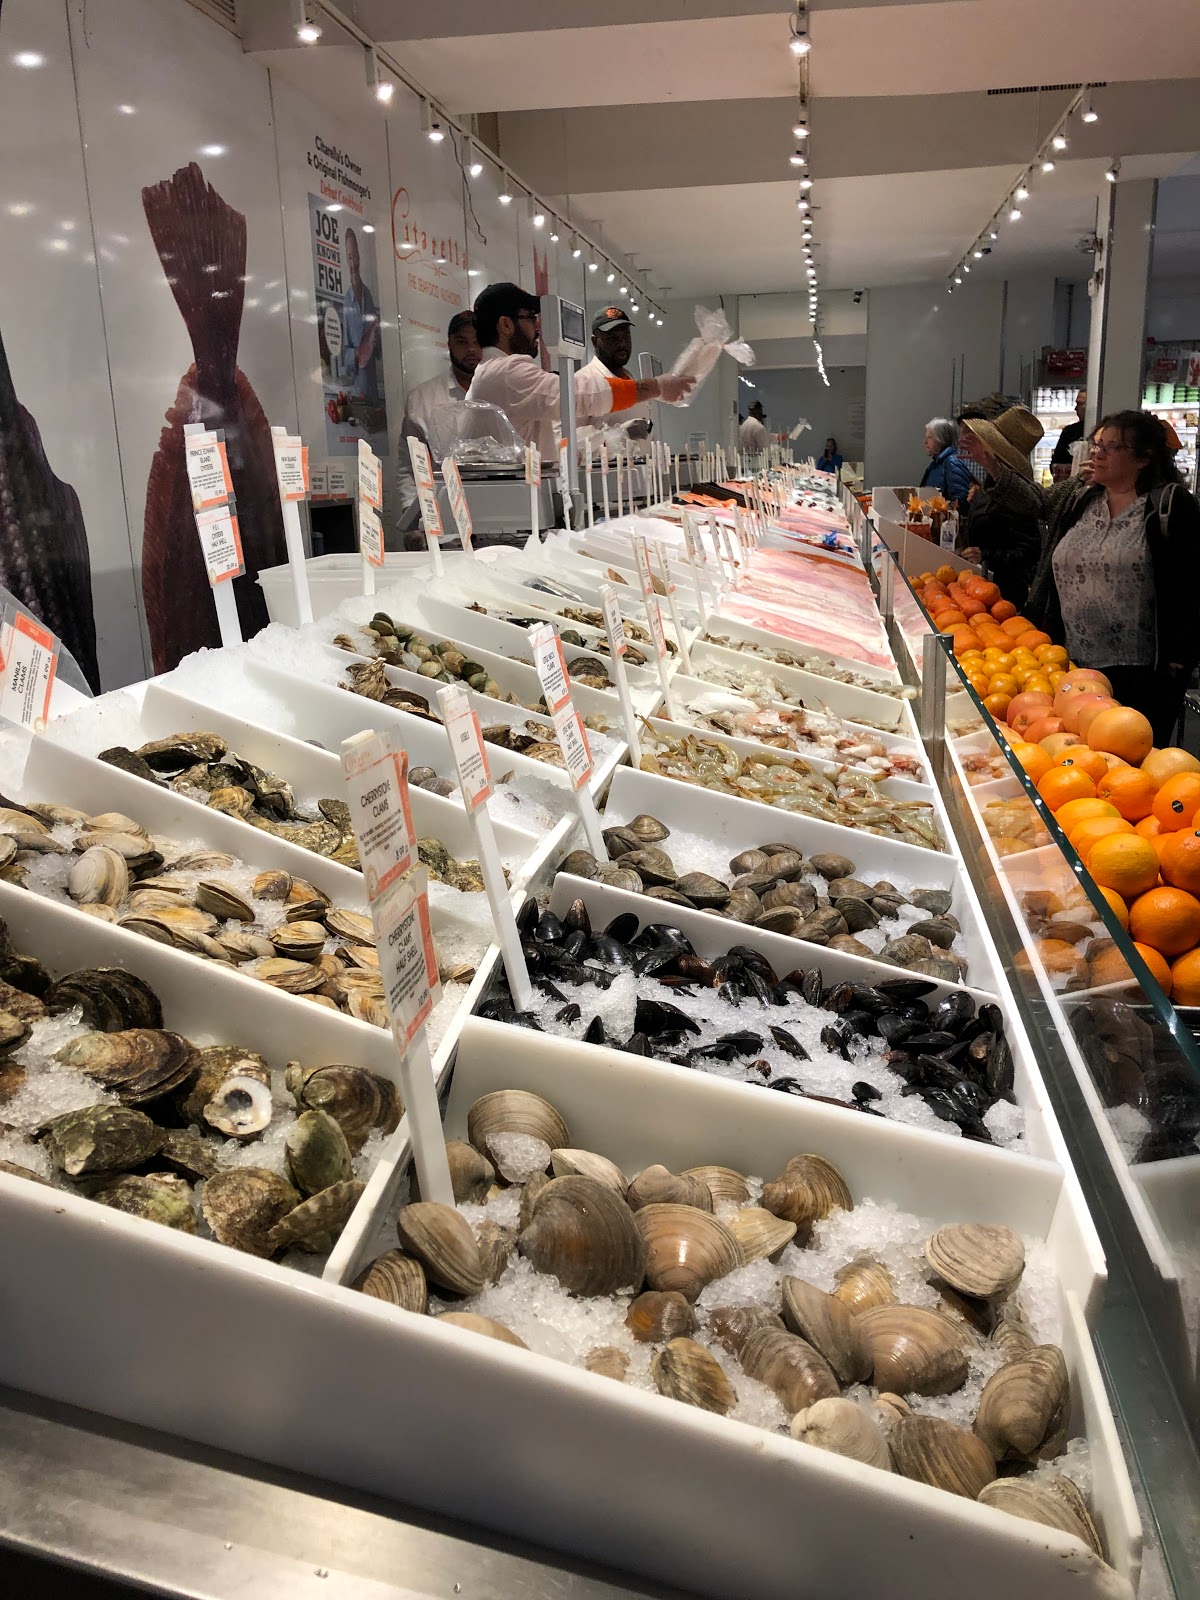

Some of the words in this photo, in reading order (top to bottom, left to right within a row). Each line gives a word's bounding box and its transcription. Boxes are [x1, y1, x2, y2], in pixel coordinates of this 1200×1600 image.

[307, 151, 312, 166] &
[314, 154, 337, 180] Original
[345, 154, 361, 176] Owner
[320, 179, 337, 201] Debut
[338, 190, 363, 214] Cookbook
[316, 209, 339, 245] JOE
[391, 187, 468, 270] Citarella
[316, 243, 340, 263] KNOWS
[318, 263, 342, 294] FISH
[12, 661, 22, 691] MANILA
[18, 665, 28, 694] CLAMS
[361, 780, 391, 807] CHERRYSTONE
[373, 799, 389, 817] CLAMS
[388, 911, 415, 947] CHERRYSTONE
[398, 932, 412, 954] CLAMS
[396, 958, 407, 975] HALF
[406, 943, 418, 964] SHELL
